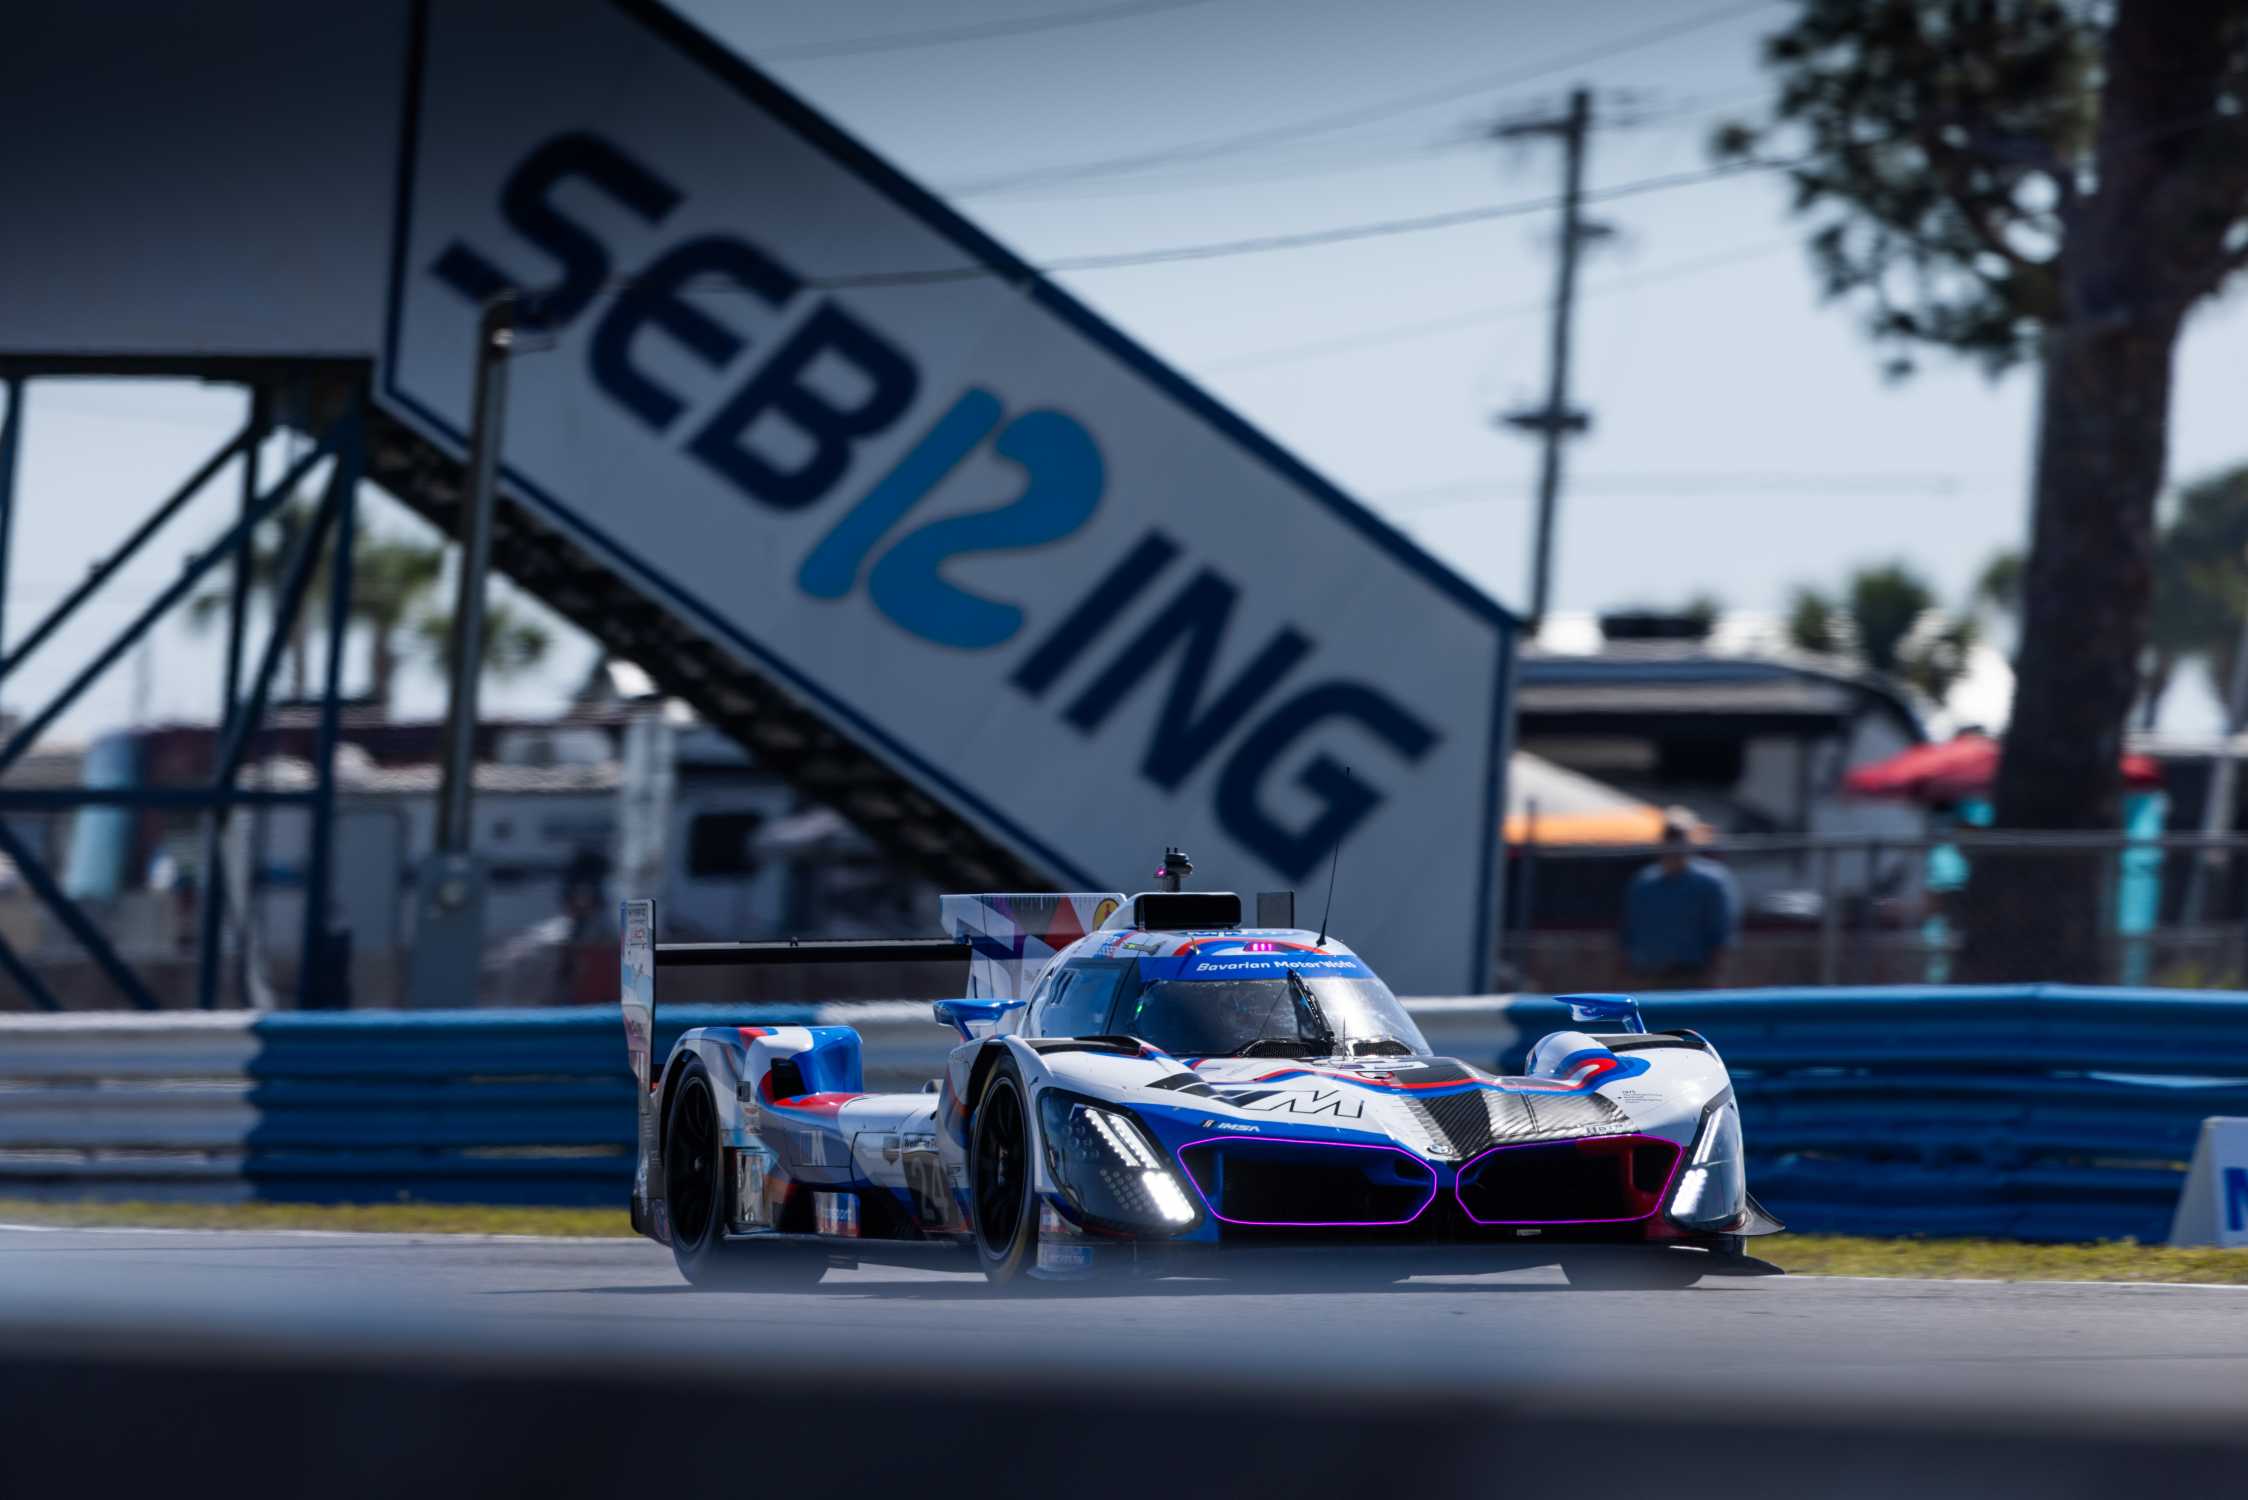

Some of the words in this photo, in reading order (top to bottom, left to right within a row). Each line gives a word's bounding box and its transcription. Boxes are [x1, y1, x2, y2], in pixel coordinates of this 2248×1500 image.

[1196, 961, 1270, 972] Bavarian
[1273, 960, 1322, 968] Motor
[1217, 1122, 1261, 1133] IMSA
